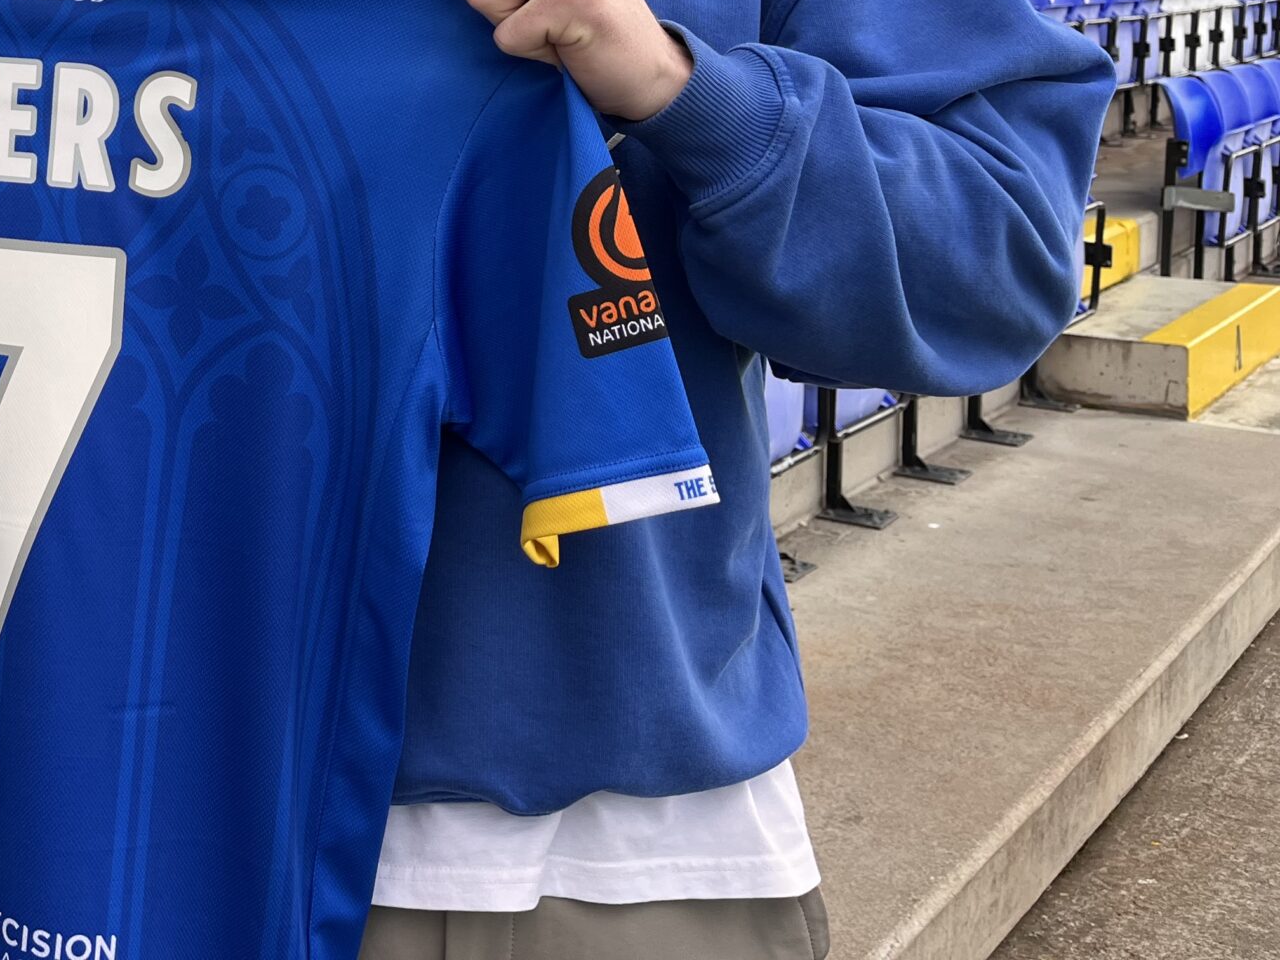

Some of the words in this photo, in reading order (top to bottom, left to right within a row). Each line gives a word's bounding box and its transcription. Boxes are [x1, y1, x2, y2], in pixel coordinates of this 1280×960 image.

[579, 290, 657, 328] vana
[588, 313, 665, 347] NATIONA
[674, 477, 708, 501] THE
